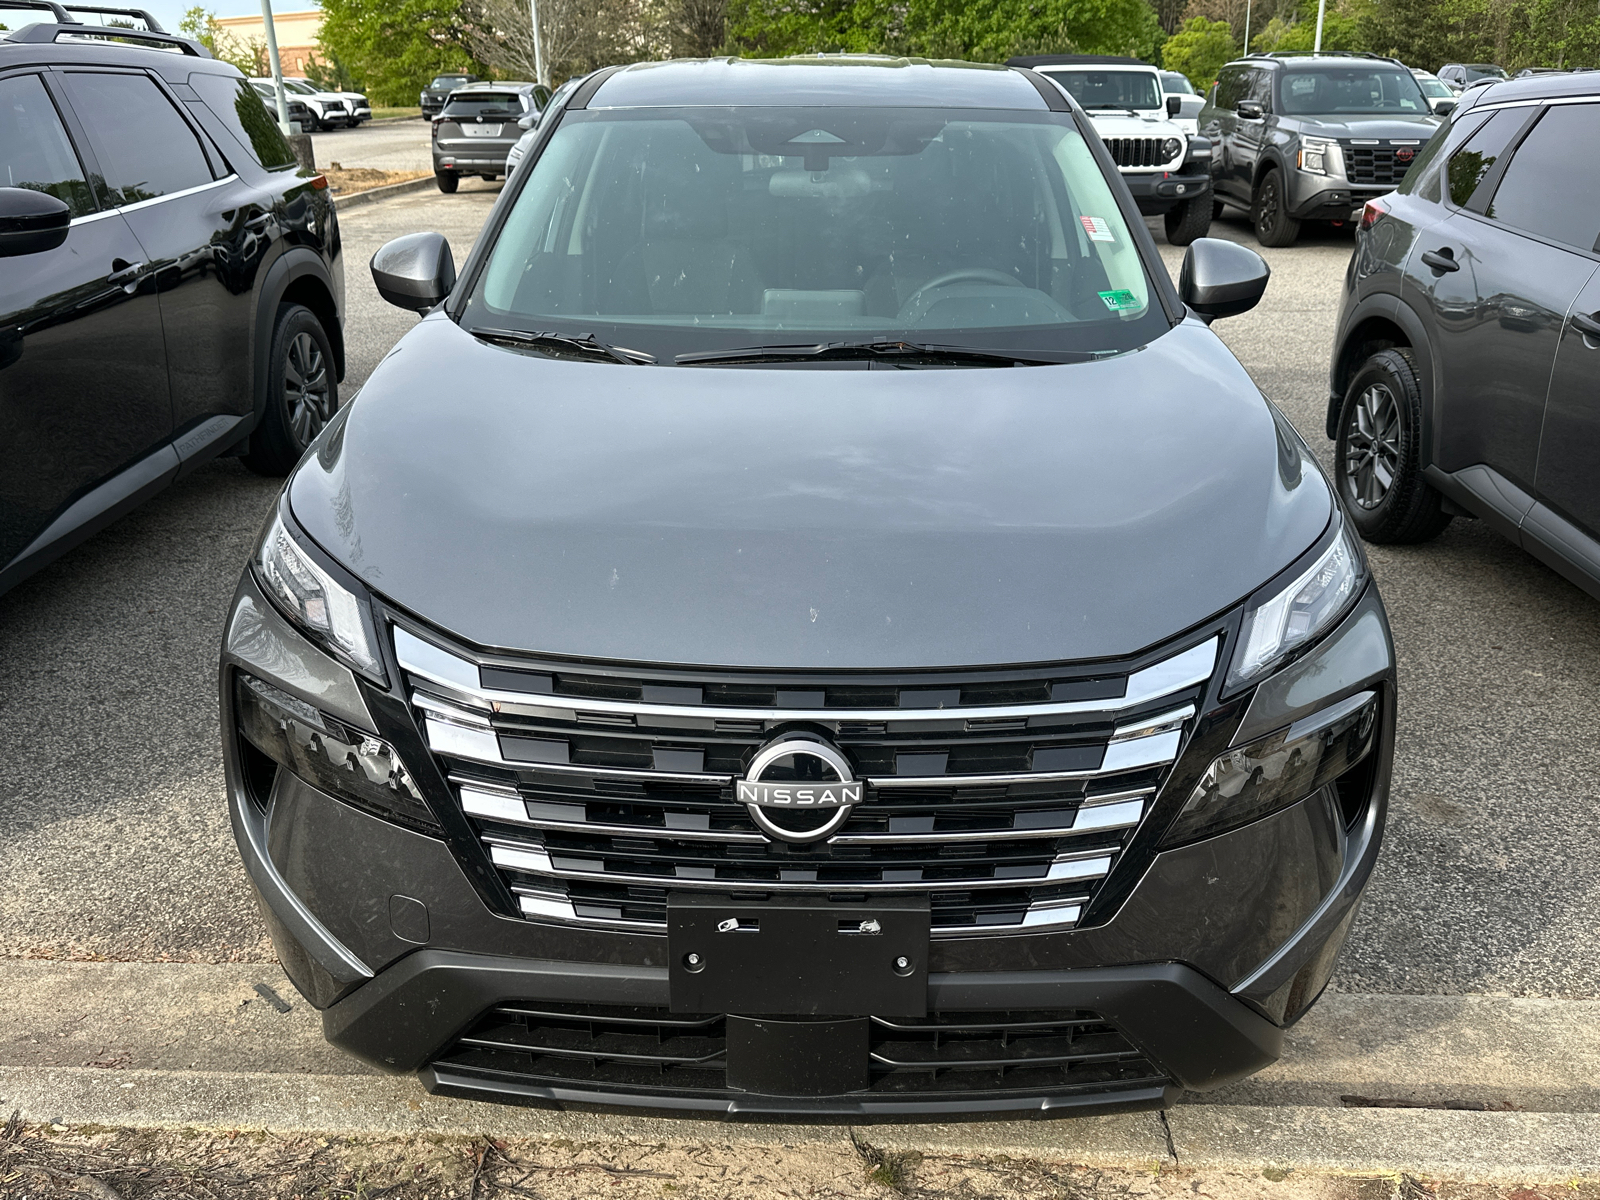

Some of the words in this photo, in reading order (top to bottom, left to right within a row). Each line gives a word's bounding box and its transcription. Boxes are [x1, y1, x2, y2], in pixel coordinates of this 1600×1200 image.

[1104, 296, 1117, 306] 12
[178, 417, 229, 453] PATHFINDER
[740, 785, 860, 804] NISSAN
